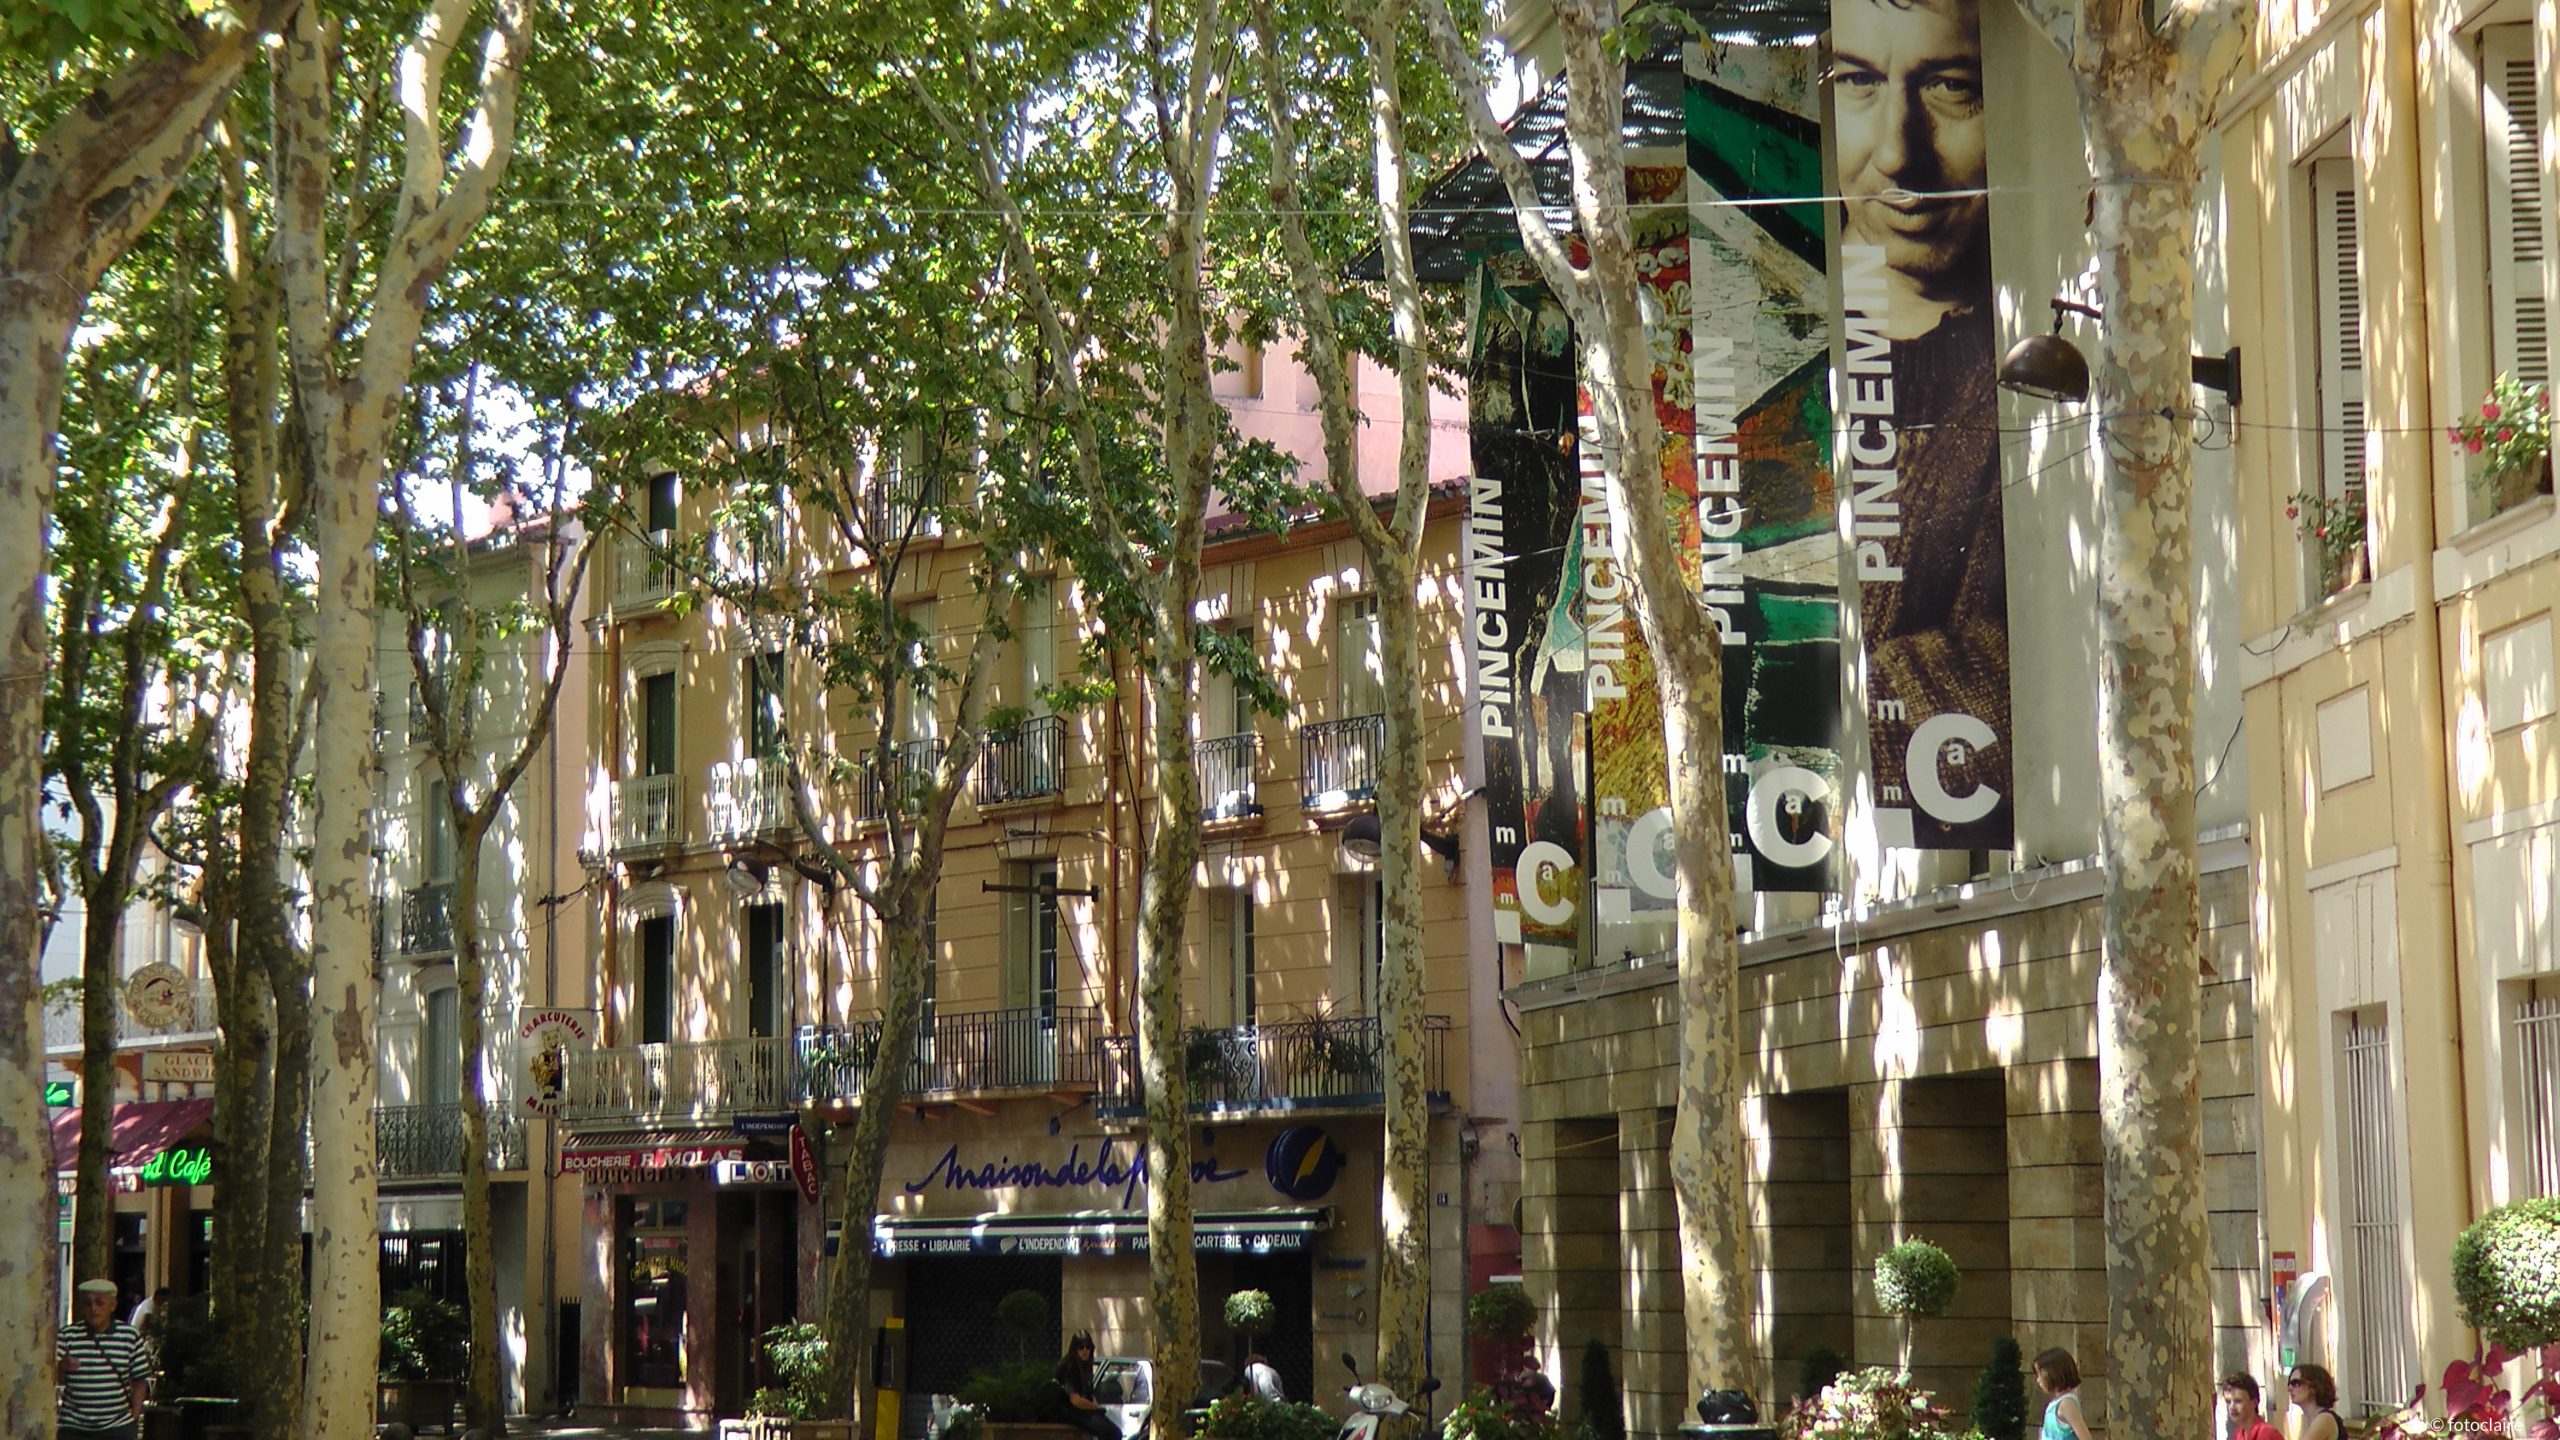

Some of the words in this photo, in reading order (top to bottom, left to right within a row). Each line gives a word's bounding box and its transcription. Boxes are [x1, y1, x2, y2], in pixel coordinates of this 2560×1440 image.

[1841, 245, 1904, 582] PINCEMIN
[1693, 337, 1747, 646] PINCEMIN
[1471, 477, 1513, 739] PINCEMIN
[522, 1011, 585, 1040] CHARCUTERIE
[526, 1096, 558, 1115] MAIS
[170, 1147, 212, 1185] Café
[565, 1154, 632, 1168] BOUCHERIE
[661, 1149, 743, 1167] MOLAS
[799, 1137, 818, 1195] TABAC
[929, 1239, 971, 1252] LIBRAIRIE
[1019, 1236, 1080, 1251] L'INDEPENDANT
[1194, 1235, 1242, 1248] CARTERIE
[1253, 1234, 1301, 1248] CADEAUX
